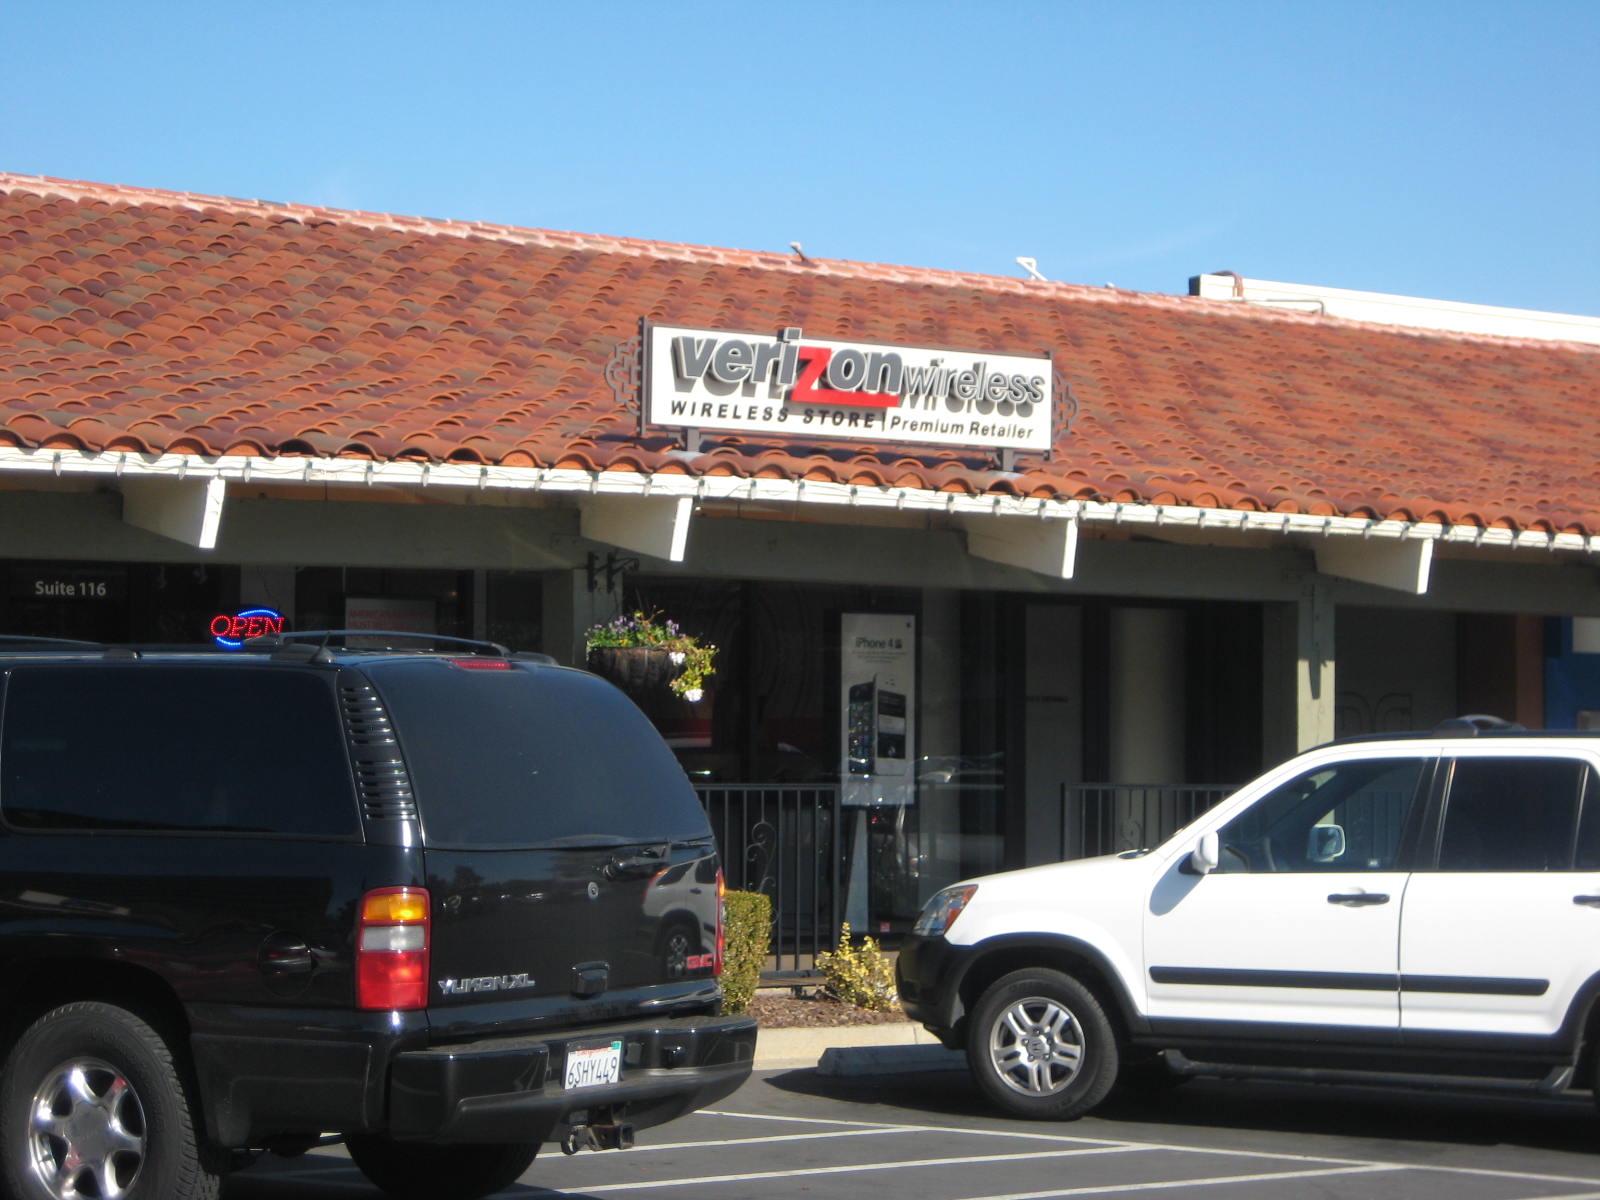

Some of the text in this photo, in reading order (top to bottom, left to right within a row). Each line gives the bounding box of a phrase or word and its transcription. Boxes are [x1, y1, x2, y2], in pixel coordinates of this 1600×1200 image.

[902, 358, 1046, 404] wireless
[671, 400, 875, 428] WIRELESS STORE
[891, 415, 1034, 439] Premium Retailer
[35, 581, 107, 596] Suite 116
[210, 615, 285, 637] OPEN
[855, 637, 886, 649] iPhone
[438, 973, 535, 995] YUKON XL
[567, 1056, 618, 1085] 6SHY449
